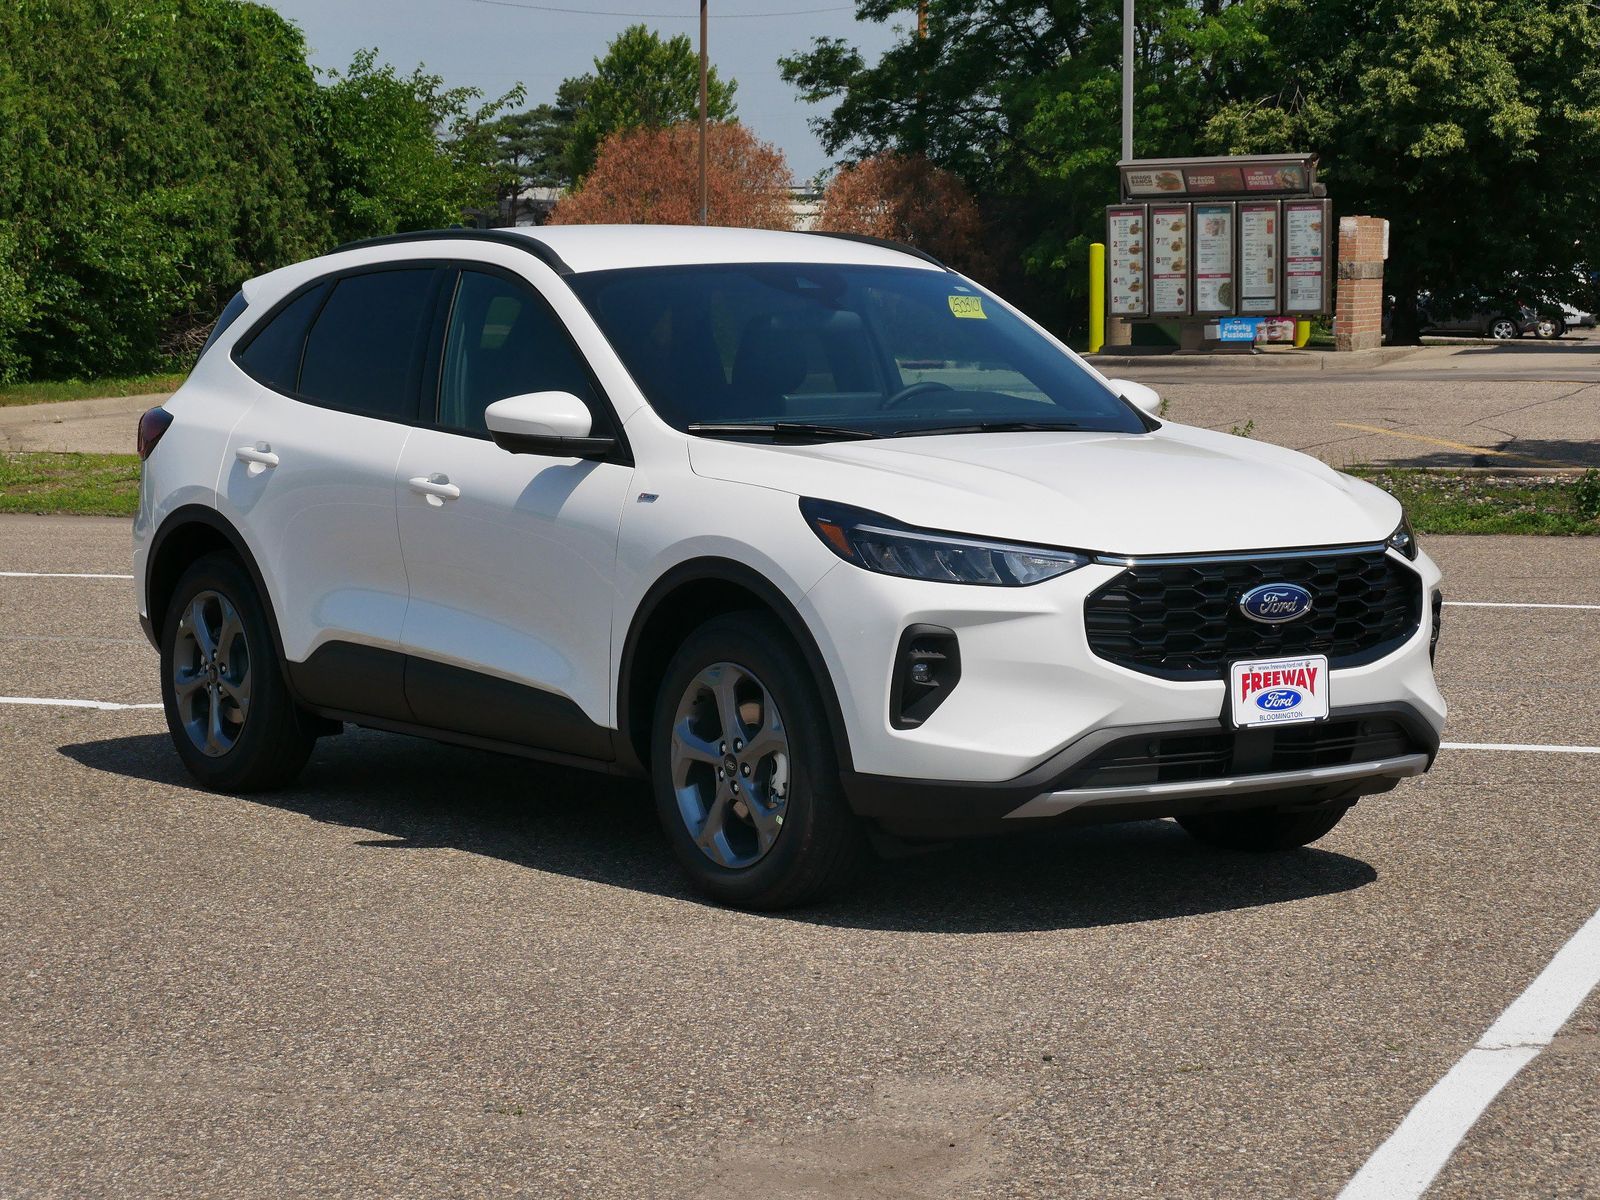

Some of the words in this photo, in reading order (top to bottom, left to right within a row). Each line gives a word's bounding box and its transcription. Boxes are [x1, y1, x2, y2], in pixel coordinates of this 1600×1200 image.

[1155, 217, 1161, 225] 6
[1155, 256, 1161, 264] 8
[1224, 323, 1252, 332] Frosty
[1222, 331, 1254, 339] Fusions
[1260, 592, 1298, 614] Ford
[1241, 668, 1317, 704] FREEWAY
[1264, 691, 1294, 708] Ford
[1259, 711, 1303, 721] BLOOMINGTON
